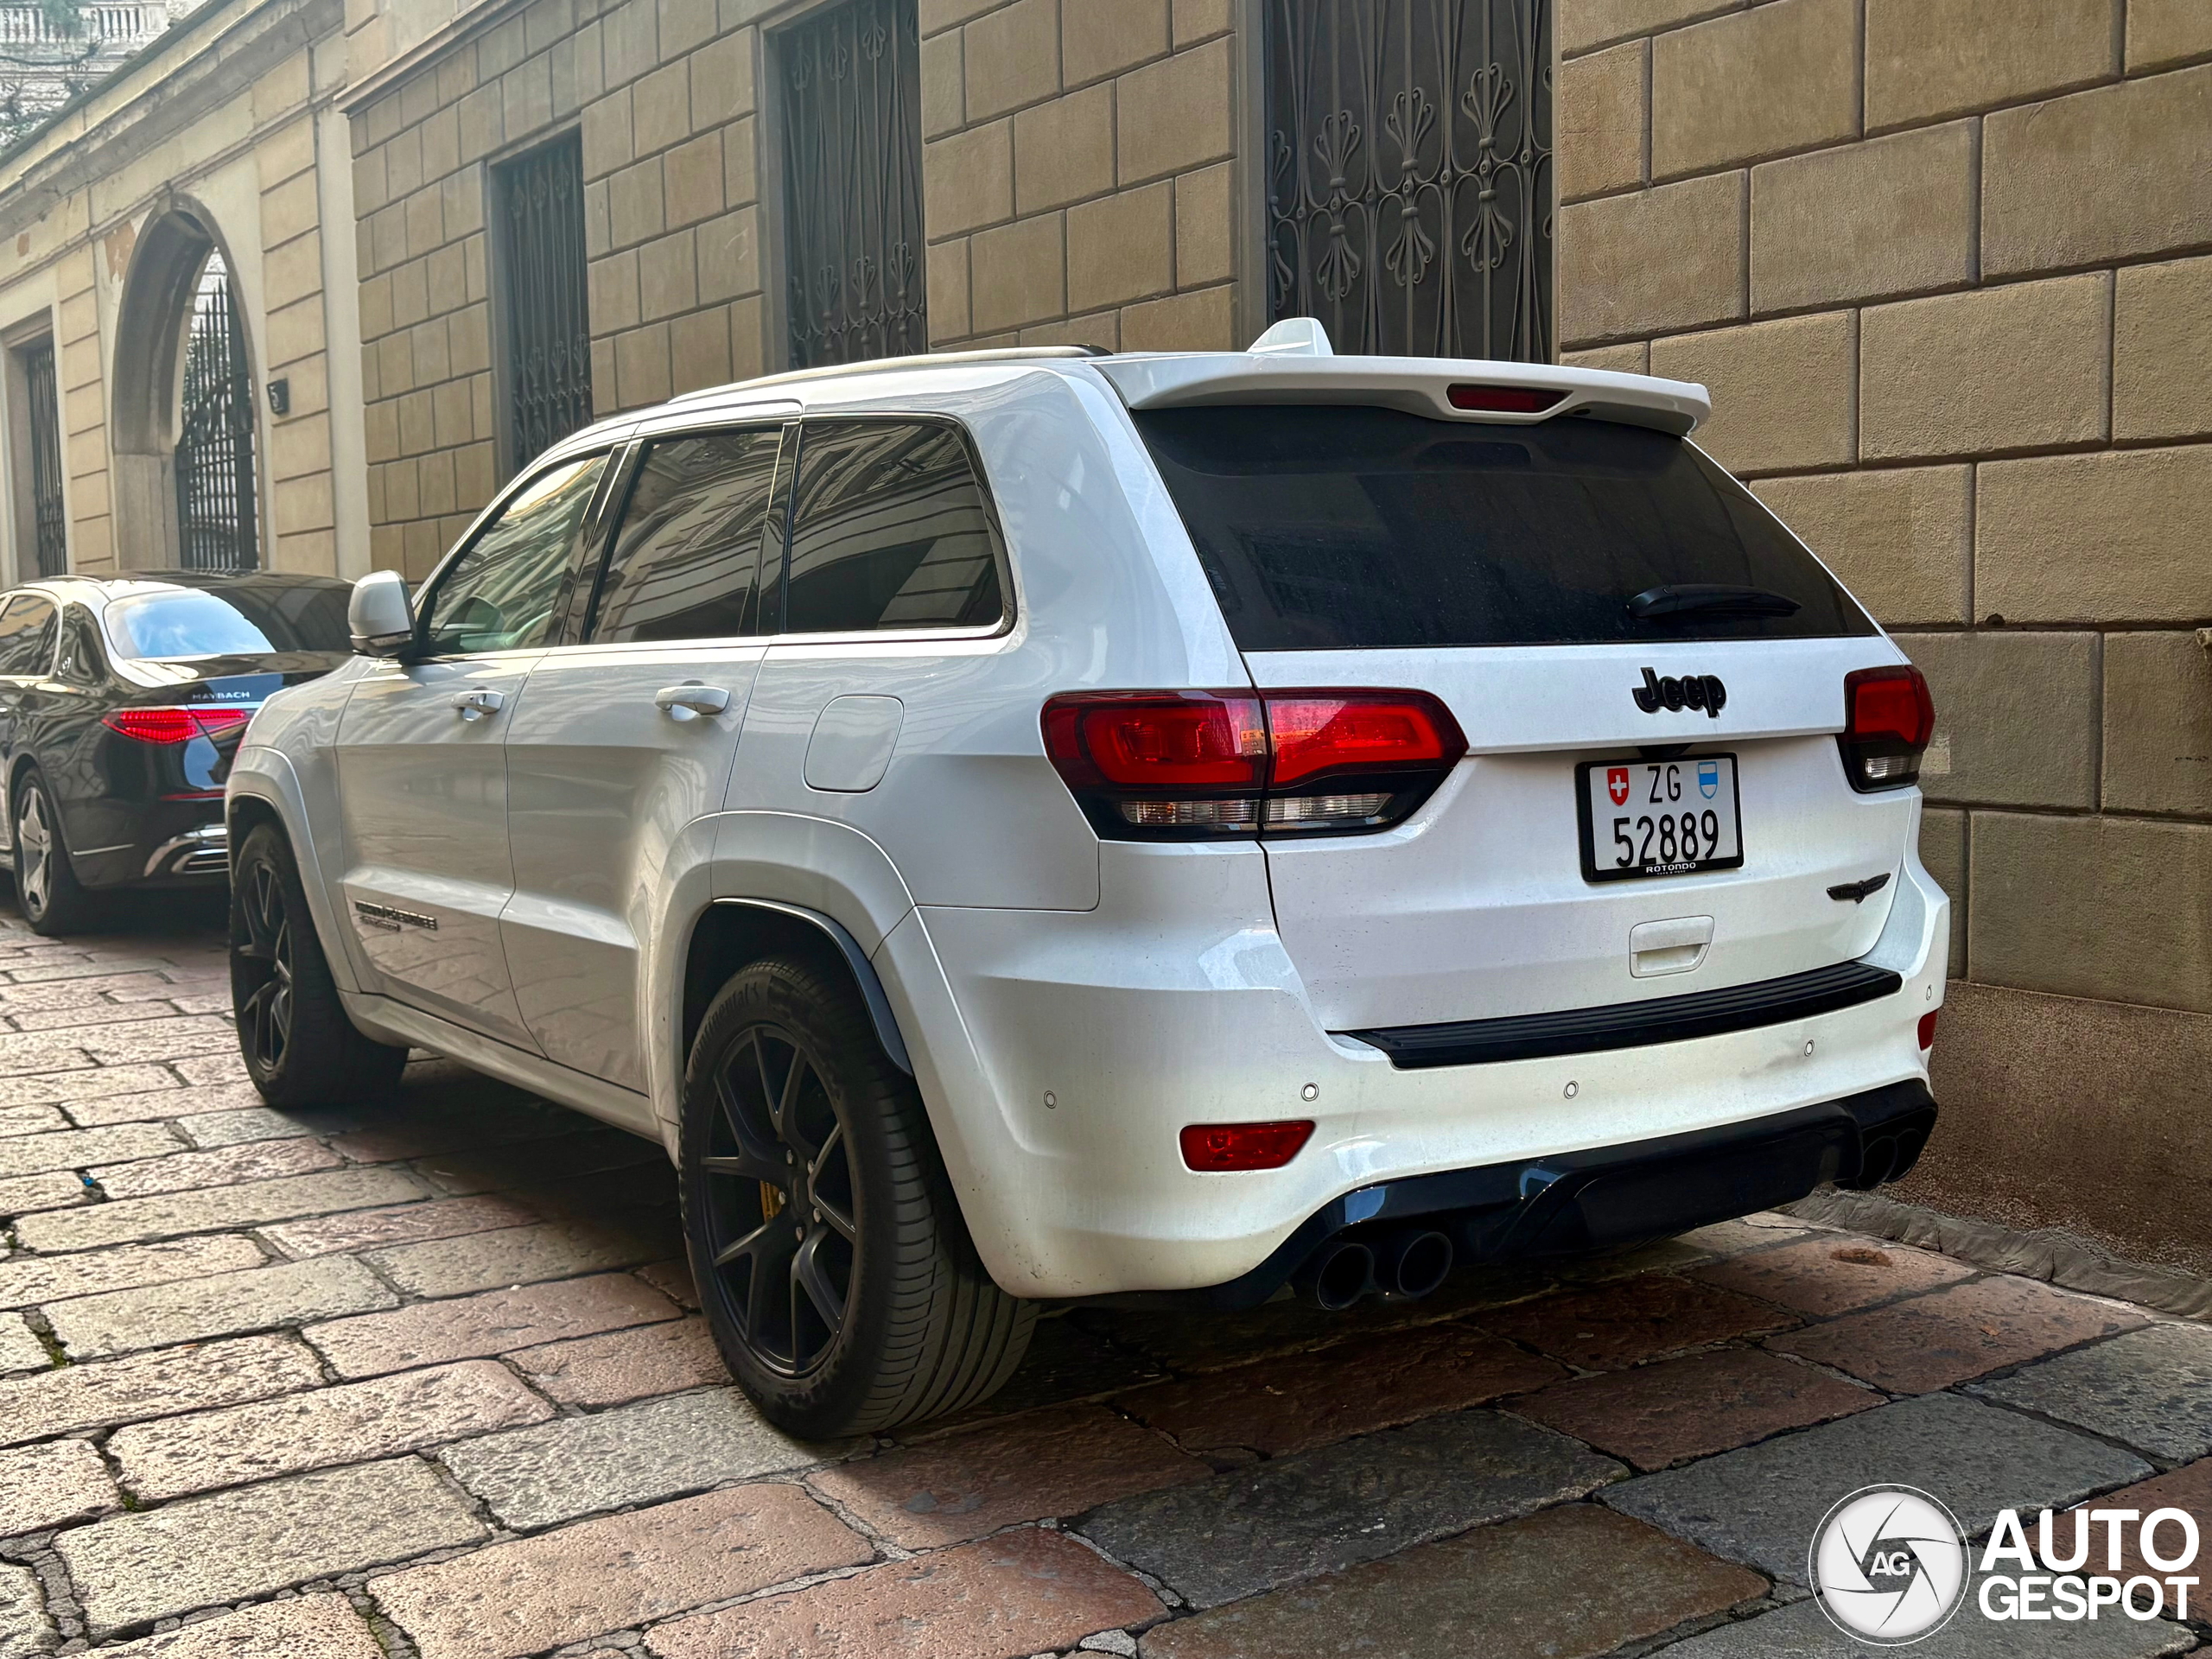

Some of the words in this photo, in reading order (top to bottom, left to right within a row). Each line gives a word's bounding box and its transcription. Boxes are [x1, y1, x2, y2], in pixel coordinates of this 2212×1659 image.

[193, 691, 250, 700] MAYBACH
[1631, 667, 1726, 718] Jeep
[1647, 765, 1681, 804] ZG
[1613, 809, 1719, 867] 52889
